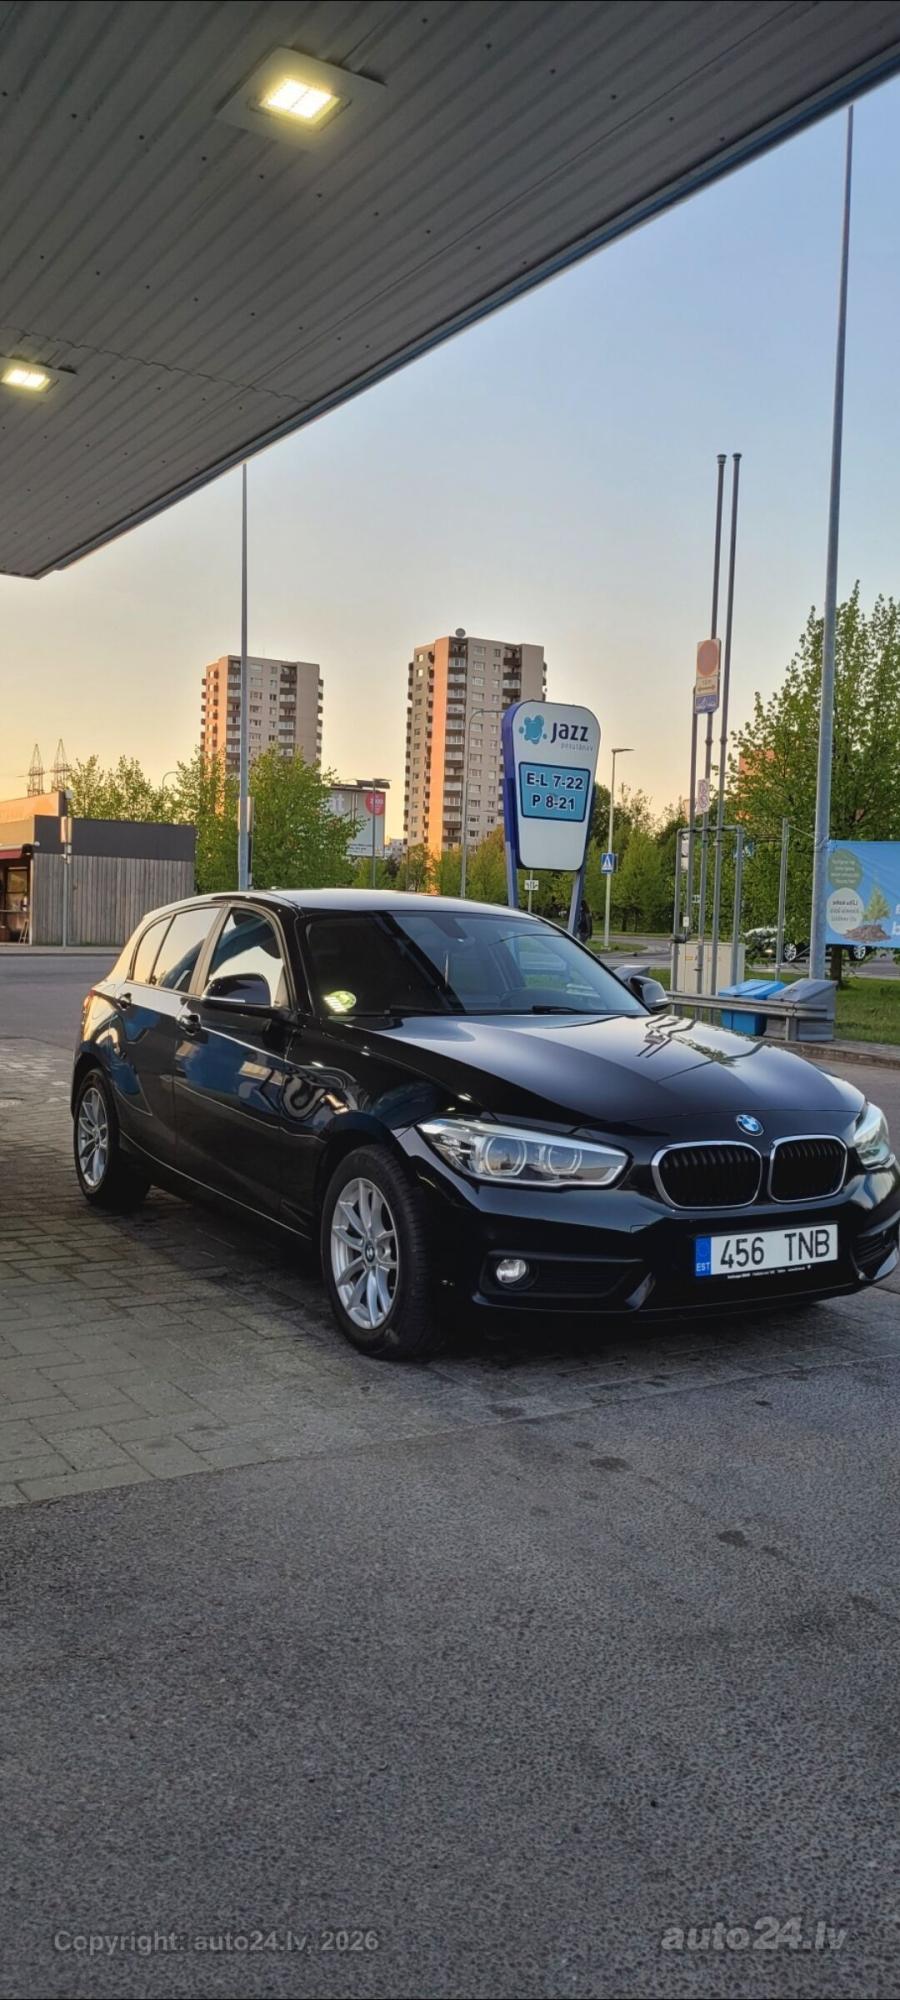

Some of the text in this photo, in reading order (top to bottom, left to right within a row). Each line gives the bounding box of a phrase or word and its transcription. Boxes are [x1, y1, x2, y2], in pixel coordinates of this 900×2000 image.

[526, 772, 584, 790] E-L 7-22
[532, 794, 575, 810] P 8-21
[720, 1229, 830, 1268] 456 TNB
[696, 1262, 710, 1272] EST
